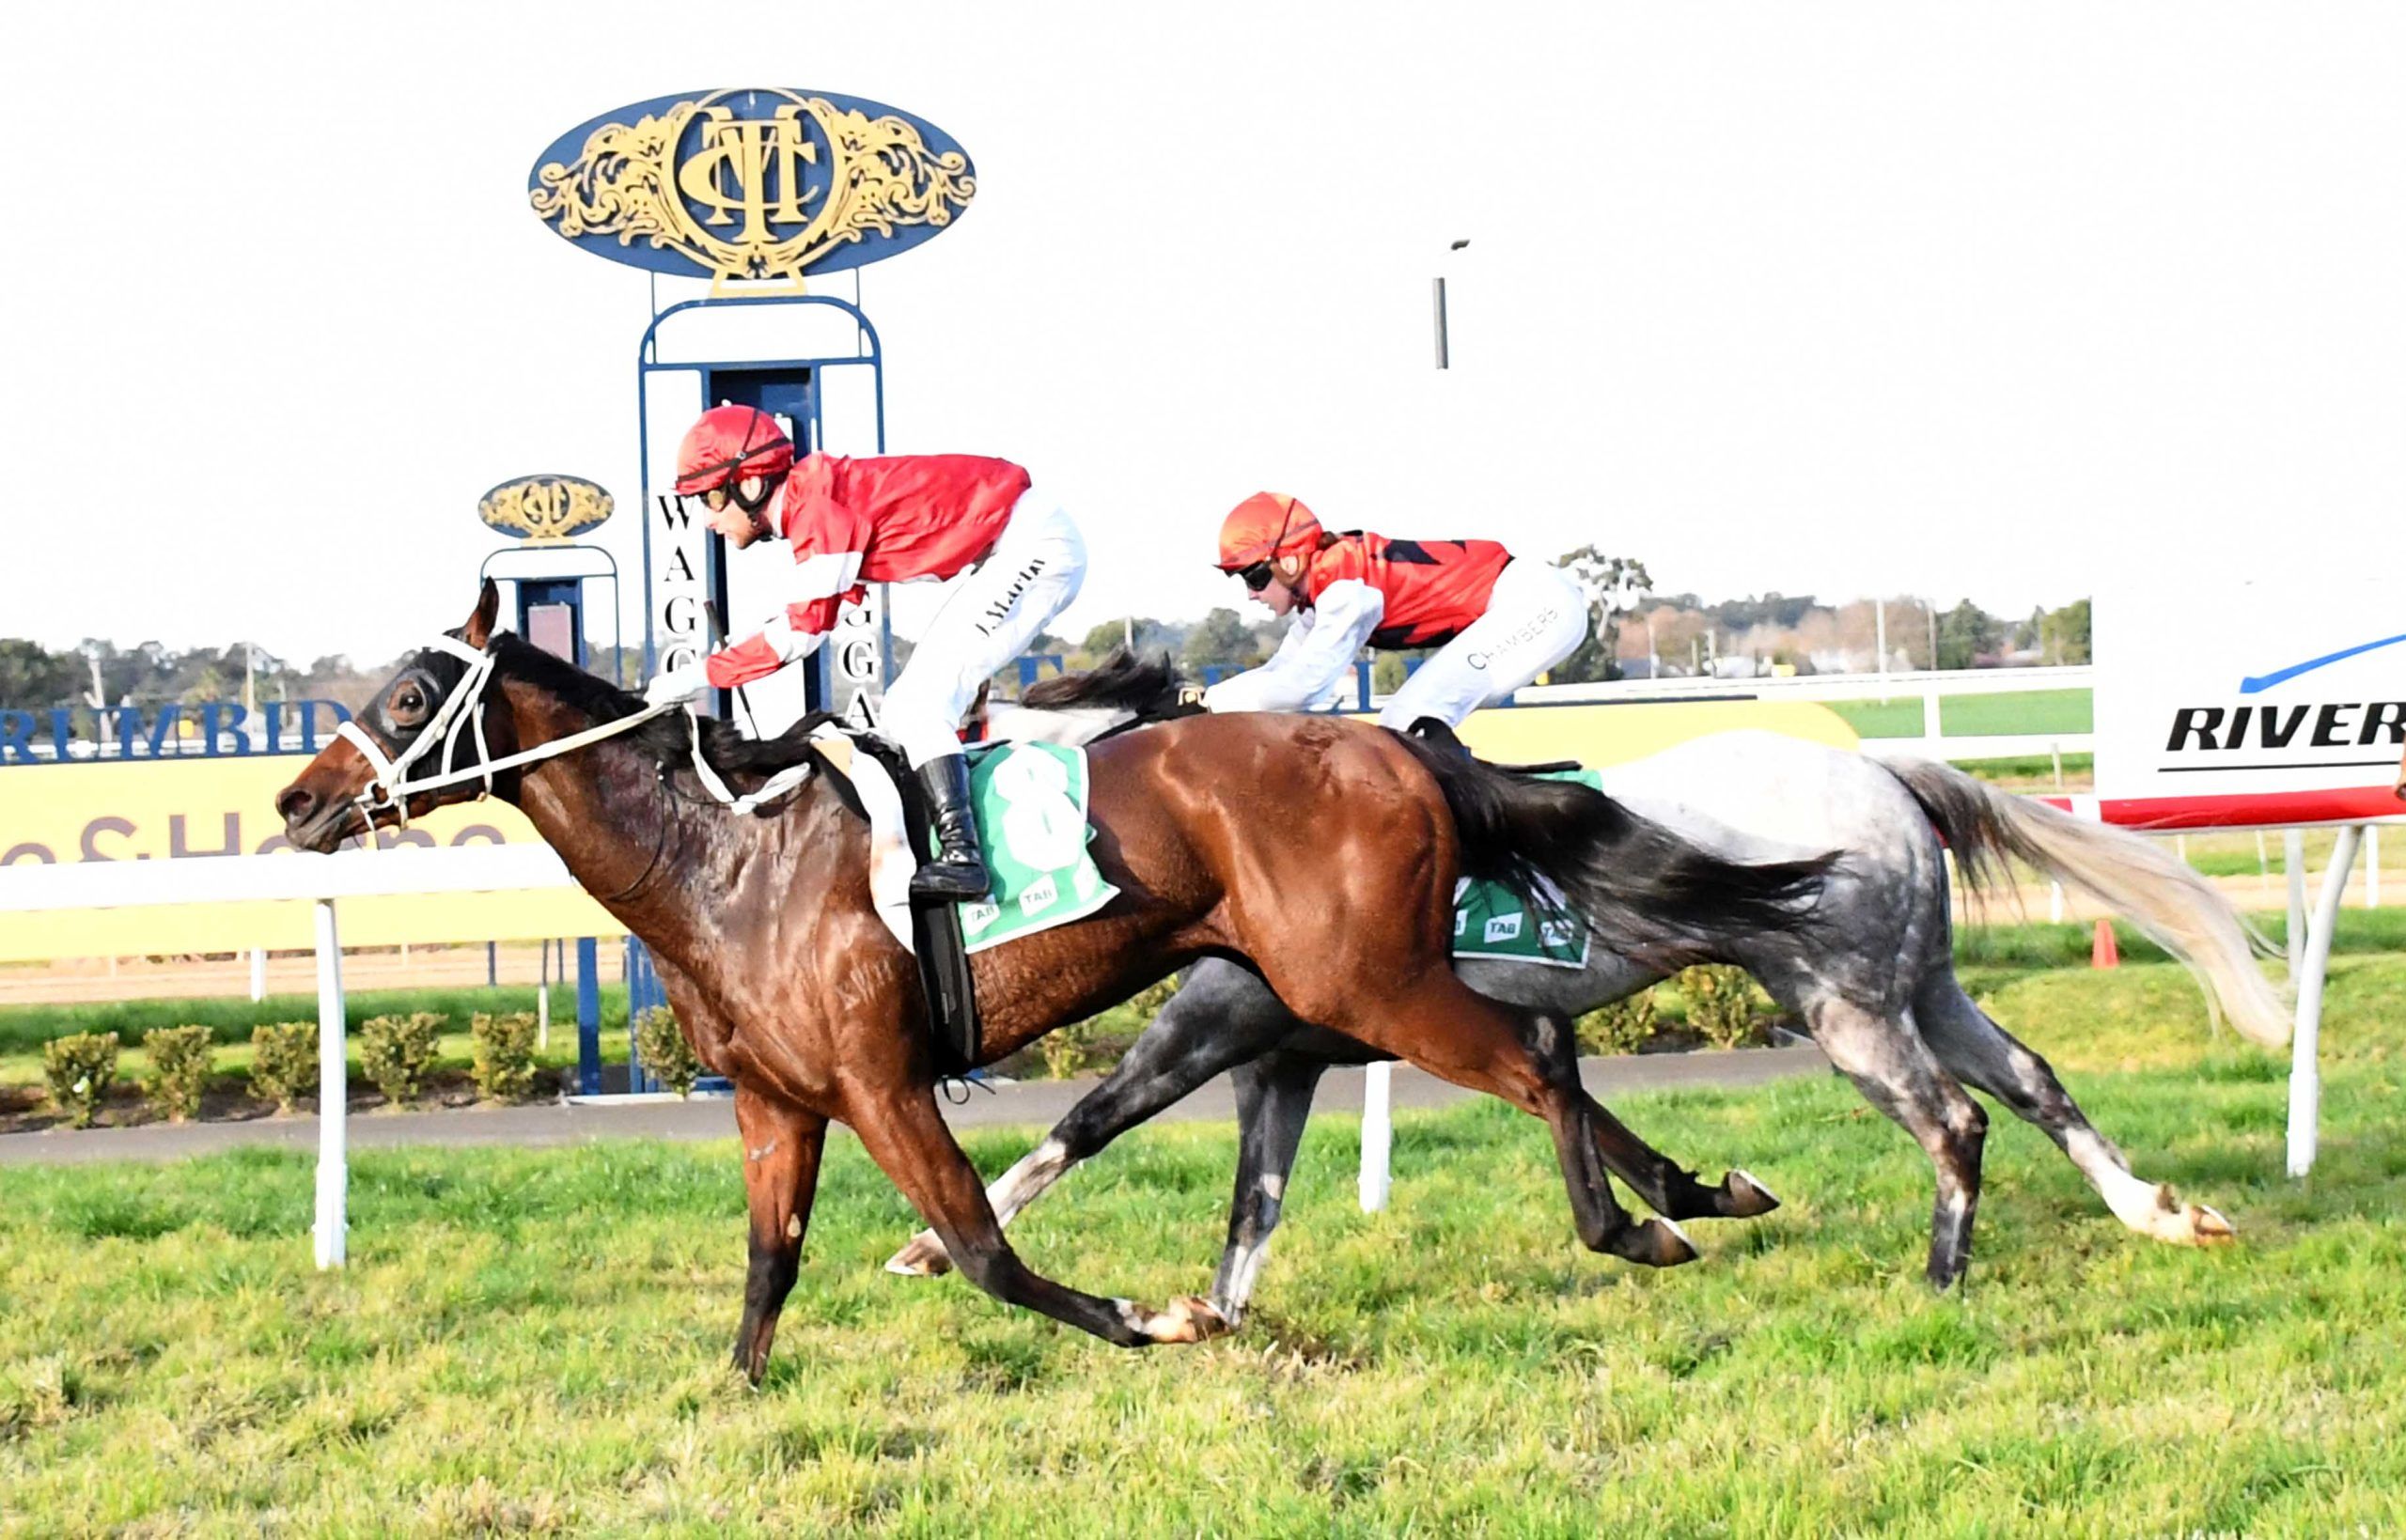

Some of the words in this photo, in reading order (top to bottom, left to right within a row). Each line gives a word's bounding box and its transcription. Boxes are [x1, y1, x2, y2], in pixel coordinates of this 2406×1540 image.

[1466, 606, 1559, 671] CHAMBERS
[2164, 701, 2406, 752] RIVER
[992, 742, 1082, 873] 8
[1490, 922, 1516, 934] TAB
